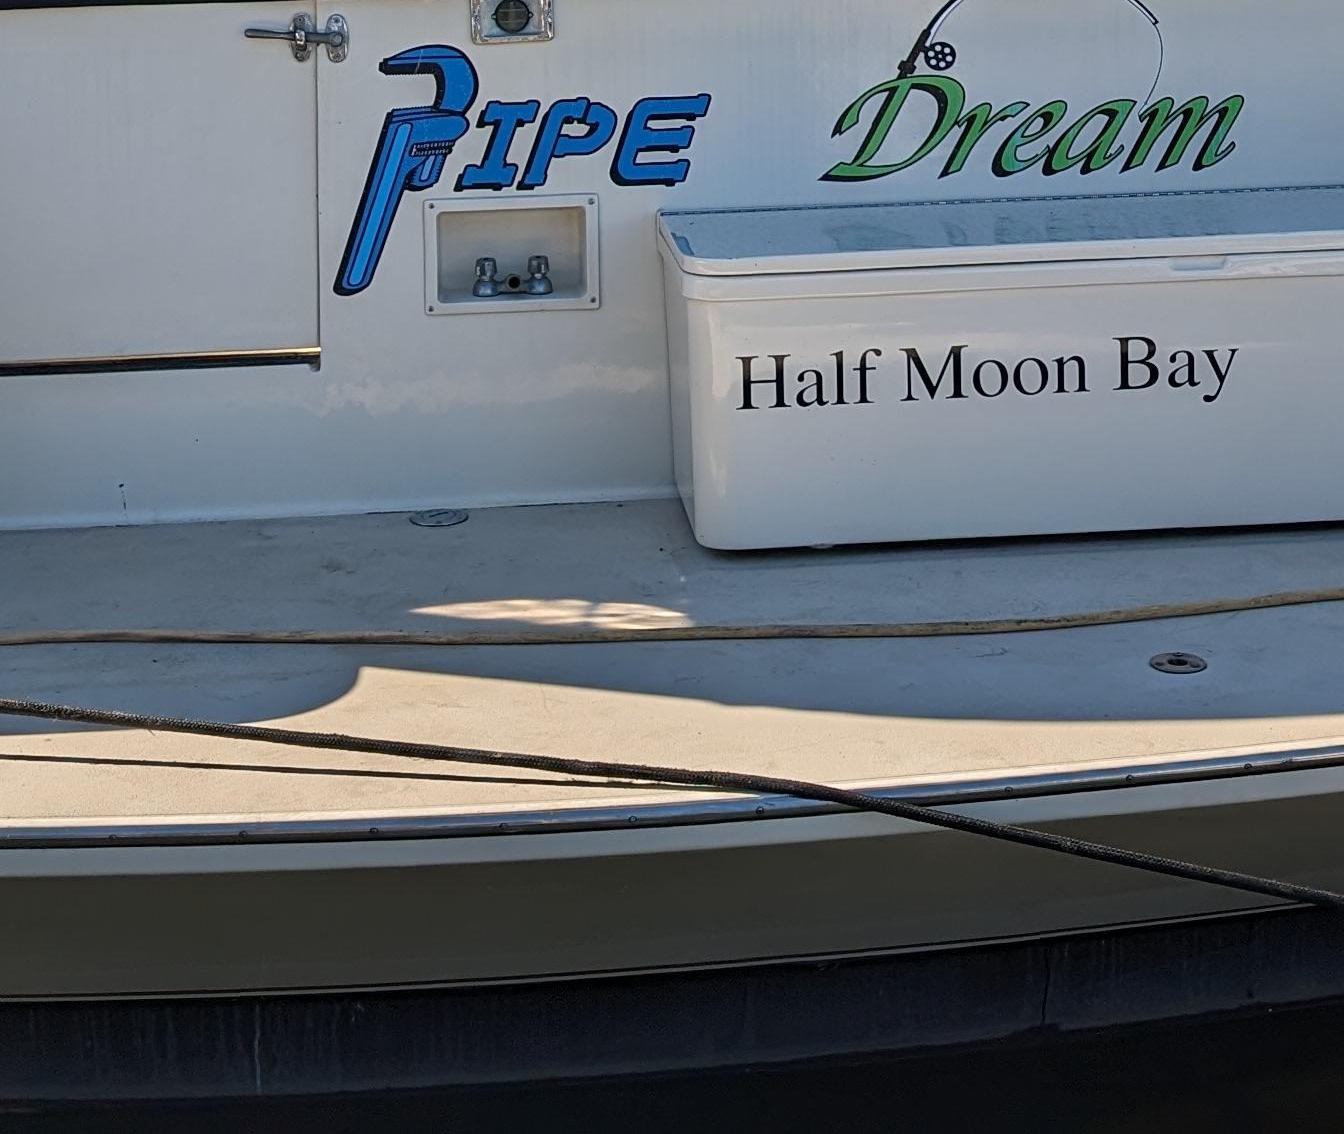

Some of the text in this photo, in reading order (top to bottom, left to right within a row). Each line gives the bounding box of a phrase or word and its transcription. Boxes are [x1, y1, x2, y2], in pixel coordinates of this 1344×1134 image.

[817, 74, 1244, 182] Dream
[735, 336, 1240, 411] Half Moon Bay
